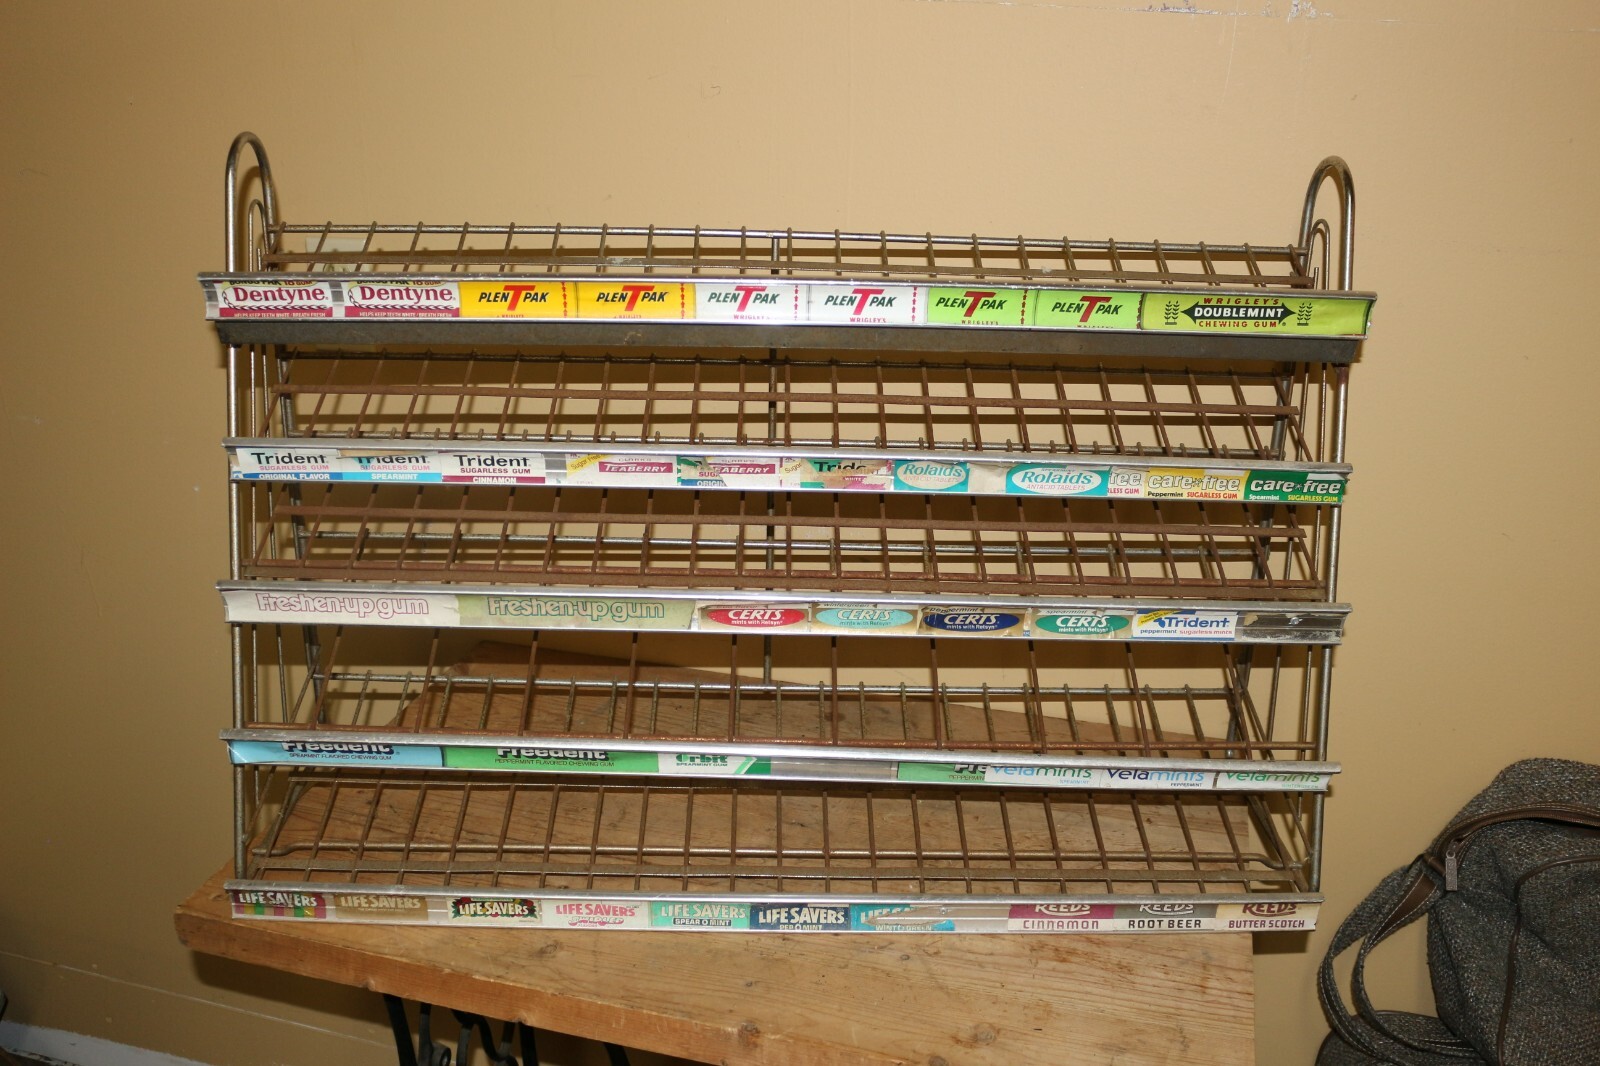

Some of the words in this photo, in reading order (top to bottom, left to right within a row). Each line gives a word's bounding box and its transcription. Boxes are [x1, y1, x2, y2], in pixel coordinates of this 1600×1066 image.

[233, 287, 326, 304] Dentyne
[360, 286, 453, 304] Dentyne
[1203, 297, 1279, 305] WRIGLEY'S
[1194, 307, 1284, 318] DOUBLEMINT
[1198, 320, 1248, 328] CHEWING
[251, 453, 327, 465] Trident
[357, 455, 427, 465] Trident
[453, 455, 530, 467] Trident
[604, 463, 667, 472] TEABERRY
[903, 463, 962, 477] Rolaids
[1021, 471, 1092, 485] Rolaids
[1147, 474, 1193, 489] care
[1200, 475, 1240, 491] free
[1250, 479, 1294, 492] care
[1302, 479, 1342, 494] free
[1147, 491, 1183, 499] Peppermint
[1249, 493, 1280, 501] Spearmint
[1287, 494, 1322, 502] SUGARLESS
[376, 597, 429, 619] gum
[610, 601, 665, 622] gum
[728, 609, 785, 620] CERTS
[837, 609, 893, 621] CERTS
[943, 614, 1000, 625] CERTS
[1056, 616, 1110, 627] CERTS
[1164, 617, 1230, 628] Trident
[676, 754, 728, 763] Orbit
[239, 893, 265, 904] LIFE
[269, 893, 318, 907] SAVERS
[340, 895, 369, 907] LIFE
[369, 895, 421, 909] SAVERS
[459, 903, 483, 914] LIFE
[484, 902, 529, 915] SAVERS
[555, 903, 583, 915] LIFE
[585, 903, 636, 917] SAVERS
[661, 904, 690, 917] LIFE
[693, 904, 747, 918] SAVERS
[759, 908, 789, 923] LIFE
[790, 908, 845, 924] SAVERS
[1128, 919, 1164, 929] ROOT
[1167, 919, 1202, 929] BEER
[1228, 920, 1266, 929] BUTTER
[1269, 920, 1304, 929] SCOTCH
